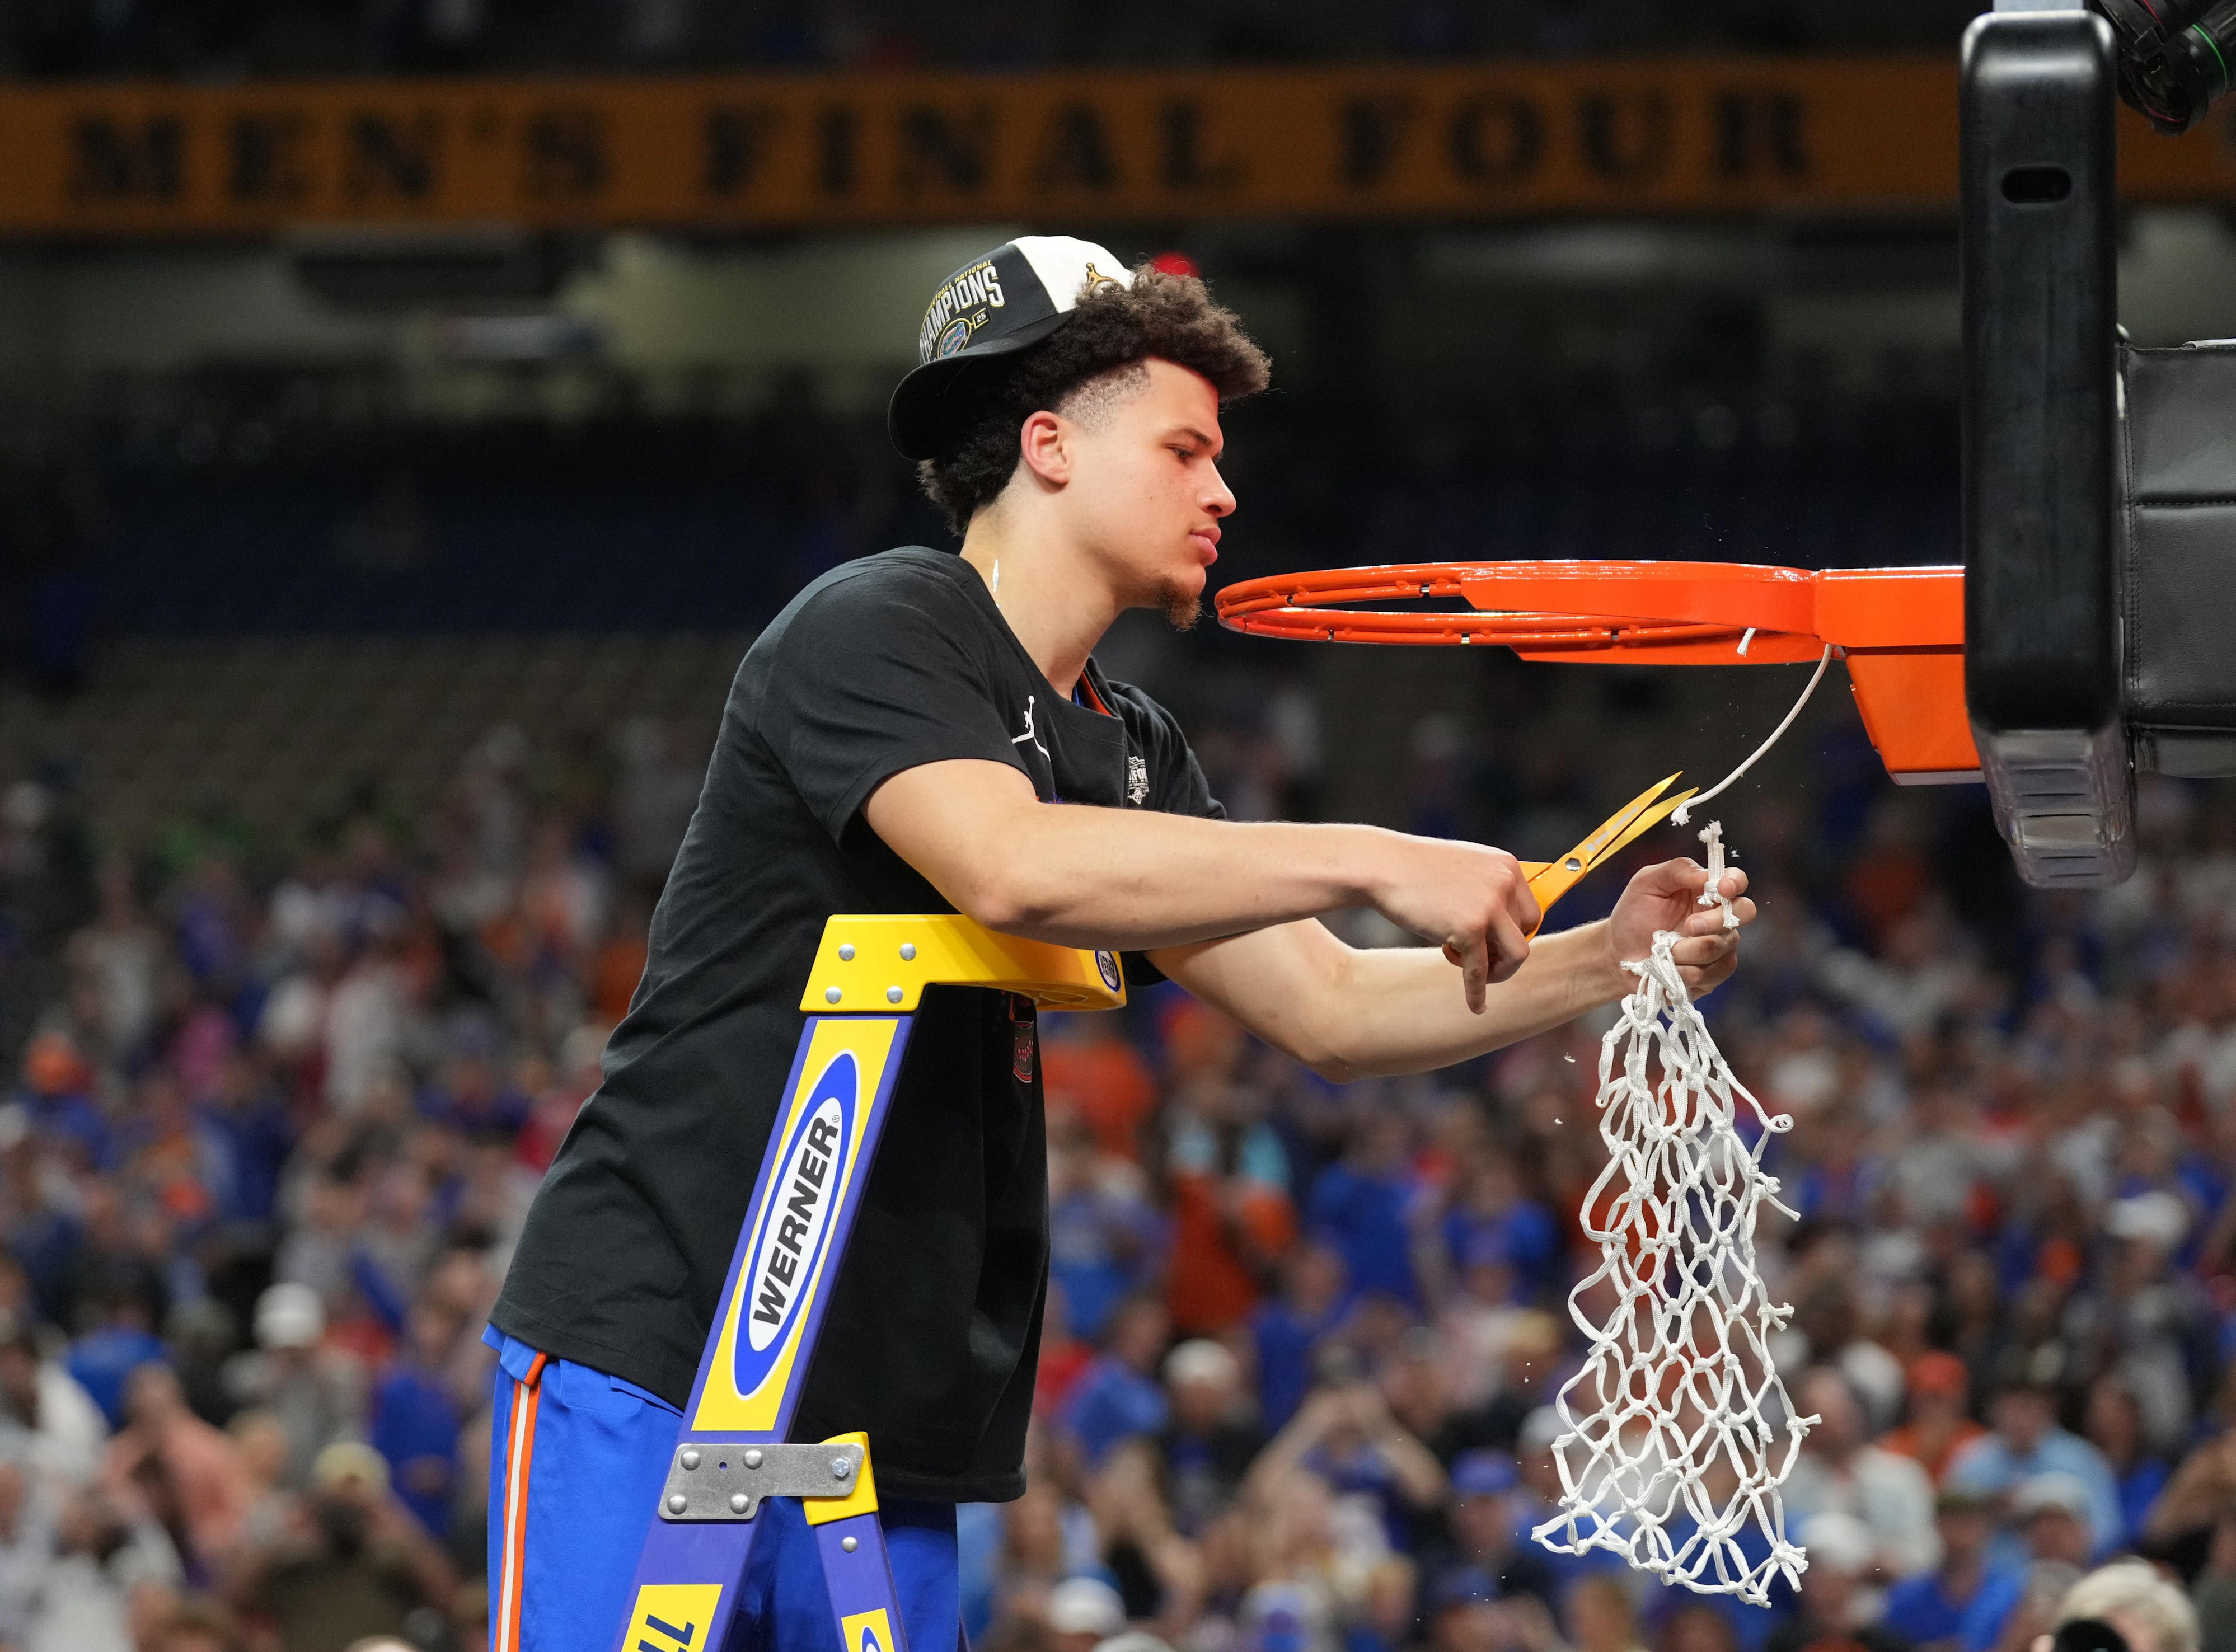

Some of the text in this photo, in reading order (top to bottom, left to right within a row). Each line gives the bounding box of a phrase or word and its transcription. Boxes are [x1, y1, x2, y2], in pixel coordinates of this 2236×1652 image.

[64, 85, 1819, 206] MEN'S FINAL FOUR
[954, 260, 993, 284] NATIONAL
[976, 312, 986, 322] 25
[753, 1116, 839, 1326] WERNER
